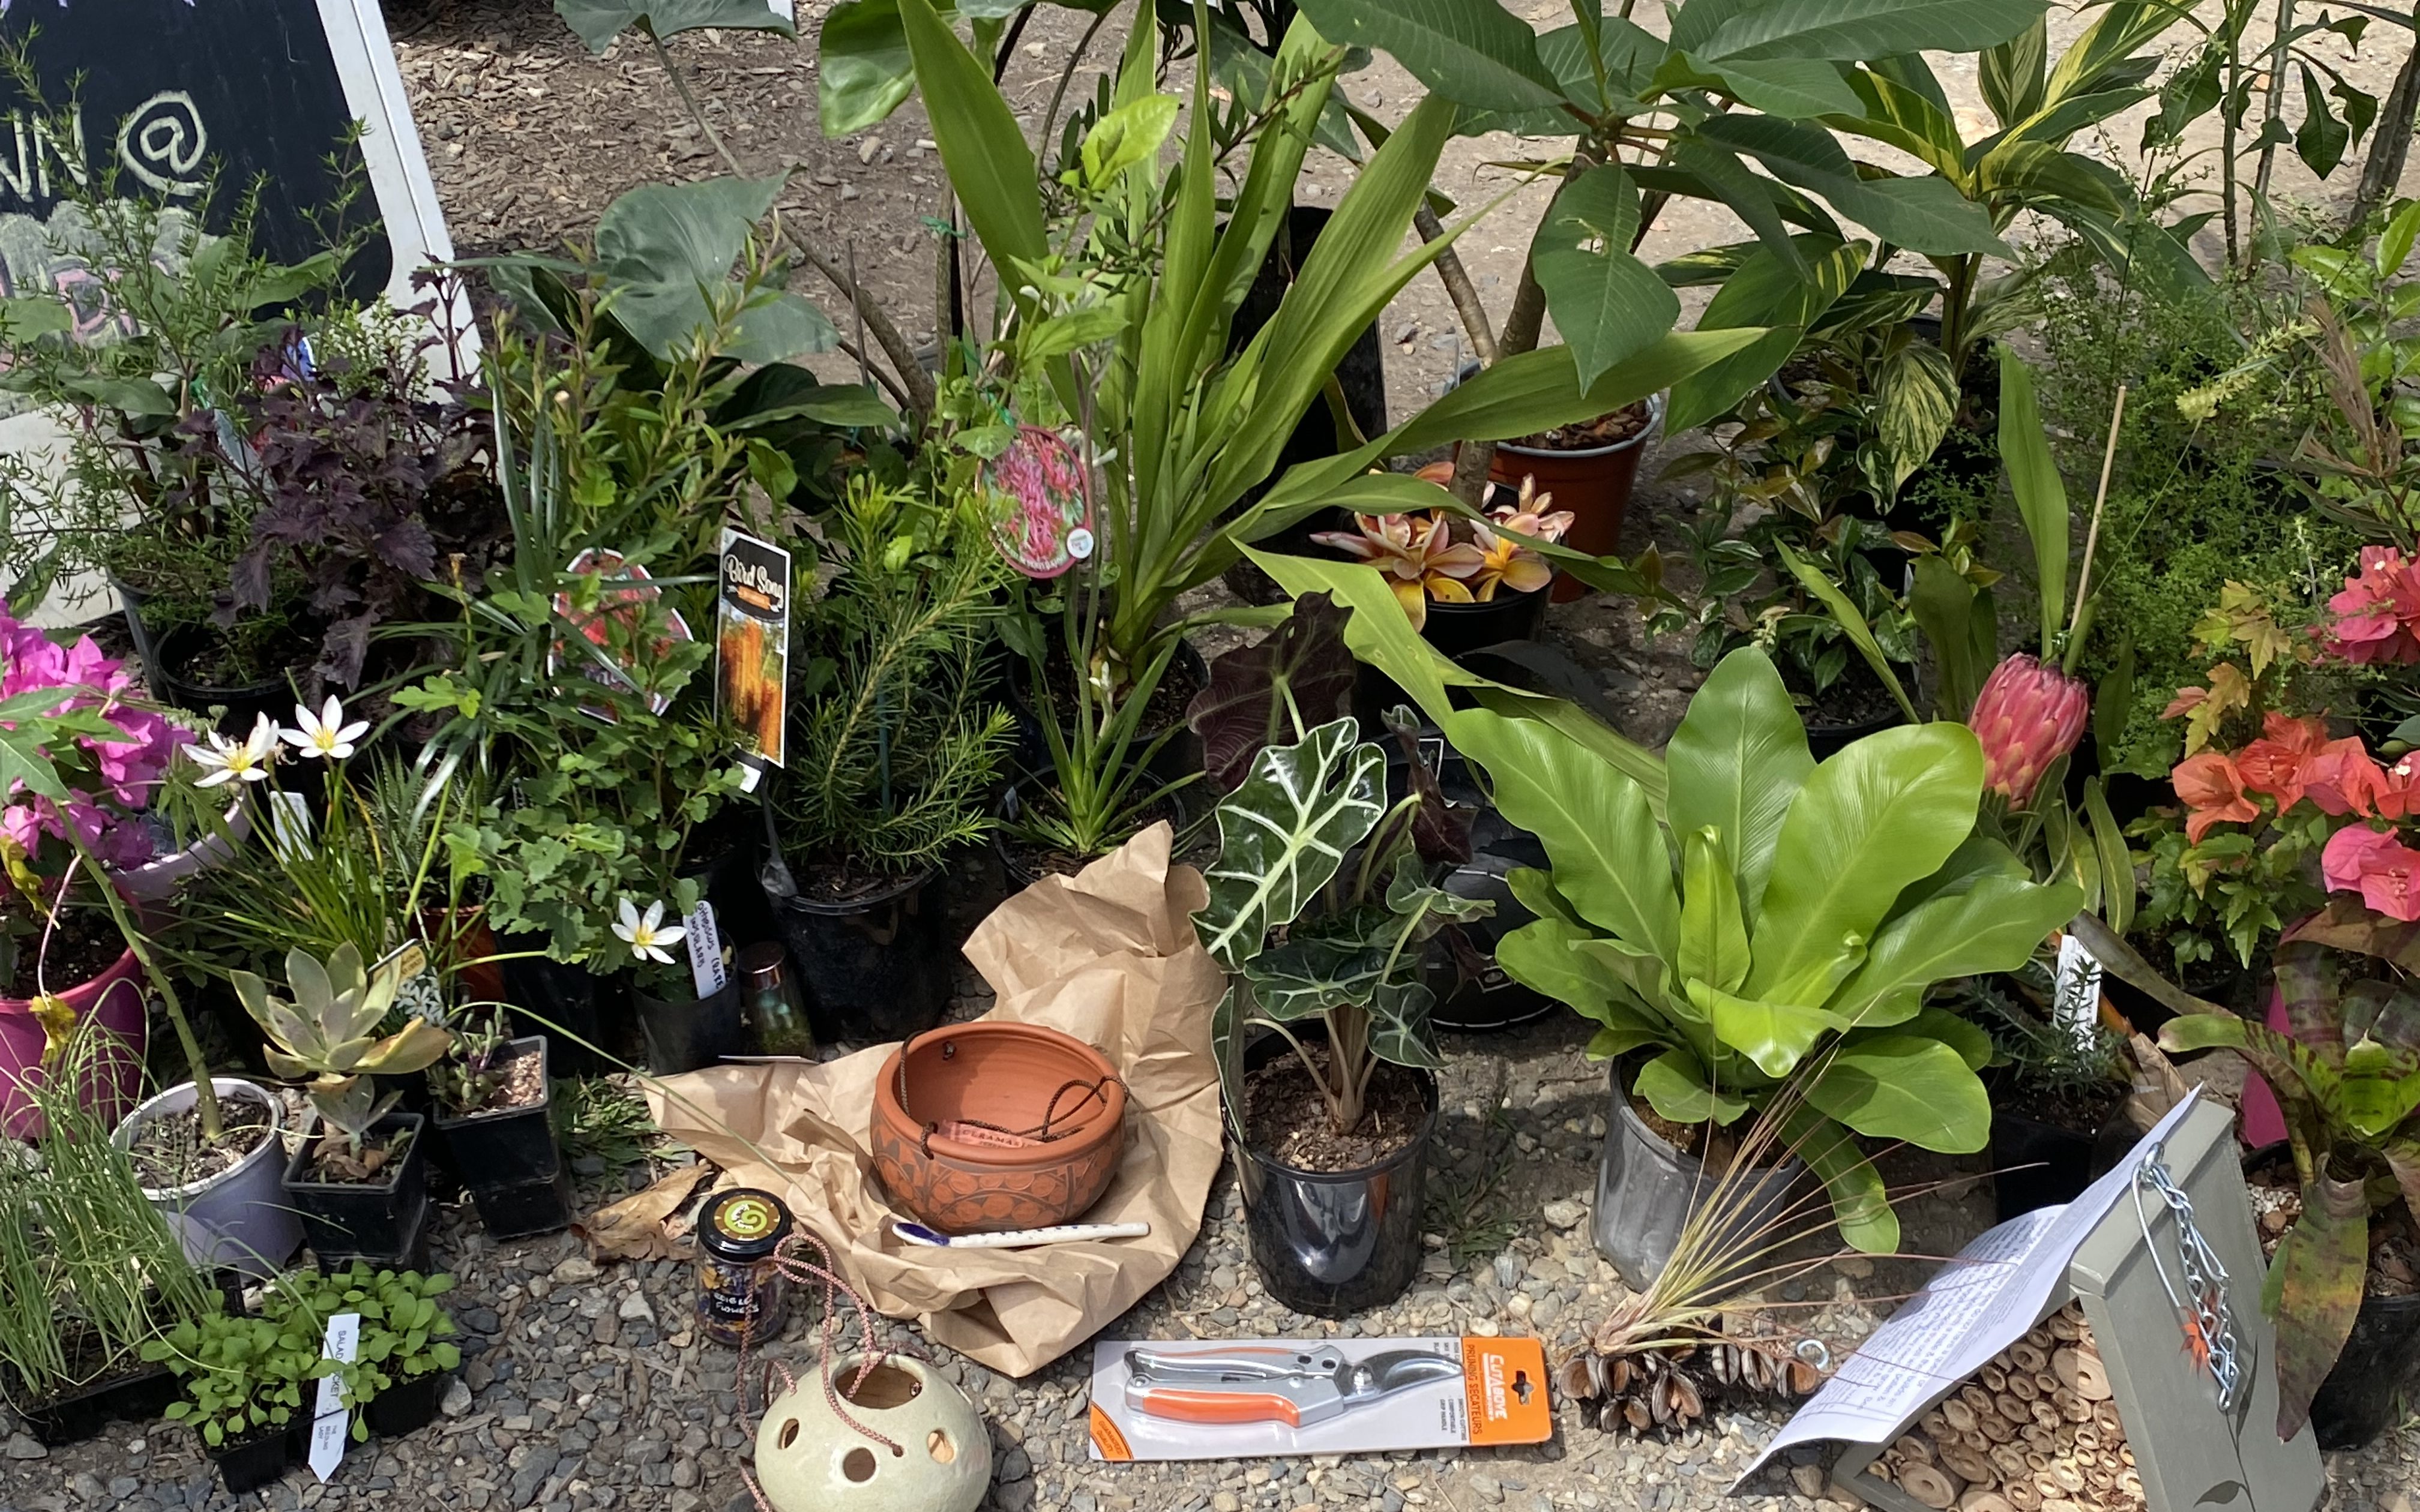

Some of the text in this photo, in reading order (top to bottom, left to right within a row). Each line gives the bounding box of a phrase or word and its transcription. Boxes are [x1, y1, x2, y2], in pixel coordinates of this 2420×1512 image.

[116, 89, 211, 197] @
[723, 554, 757, 587] Bird
[757, 565, 784, 609] Song
[336, 1330, 346, 1359] SALAD
[1466, 1344, 1478, 1381] PRUNING
[1469, 1384, 1482, 1435] SECATEURS
